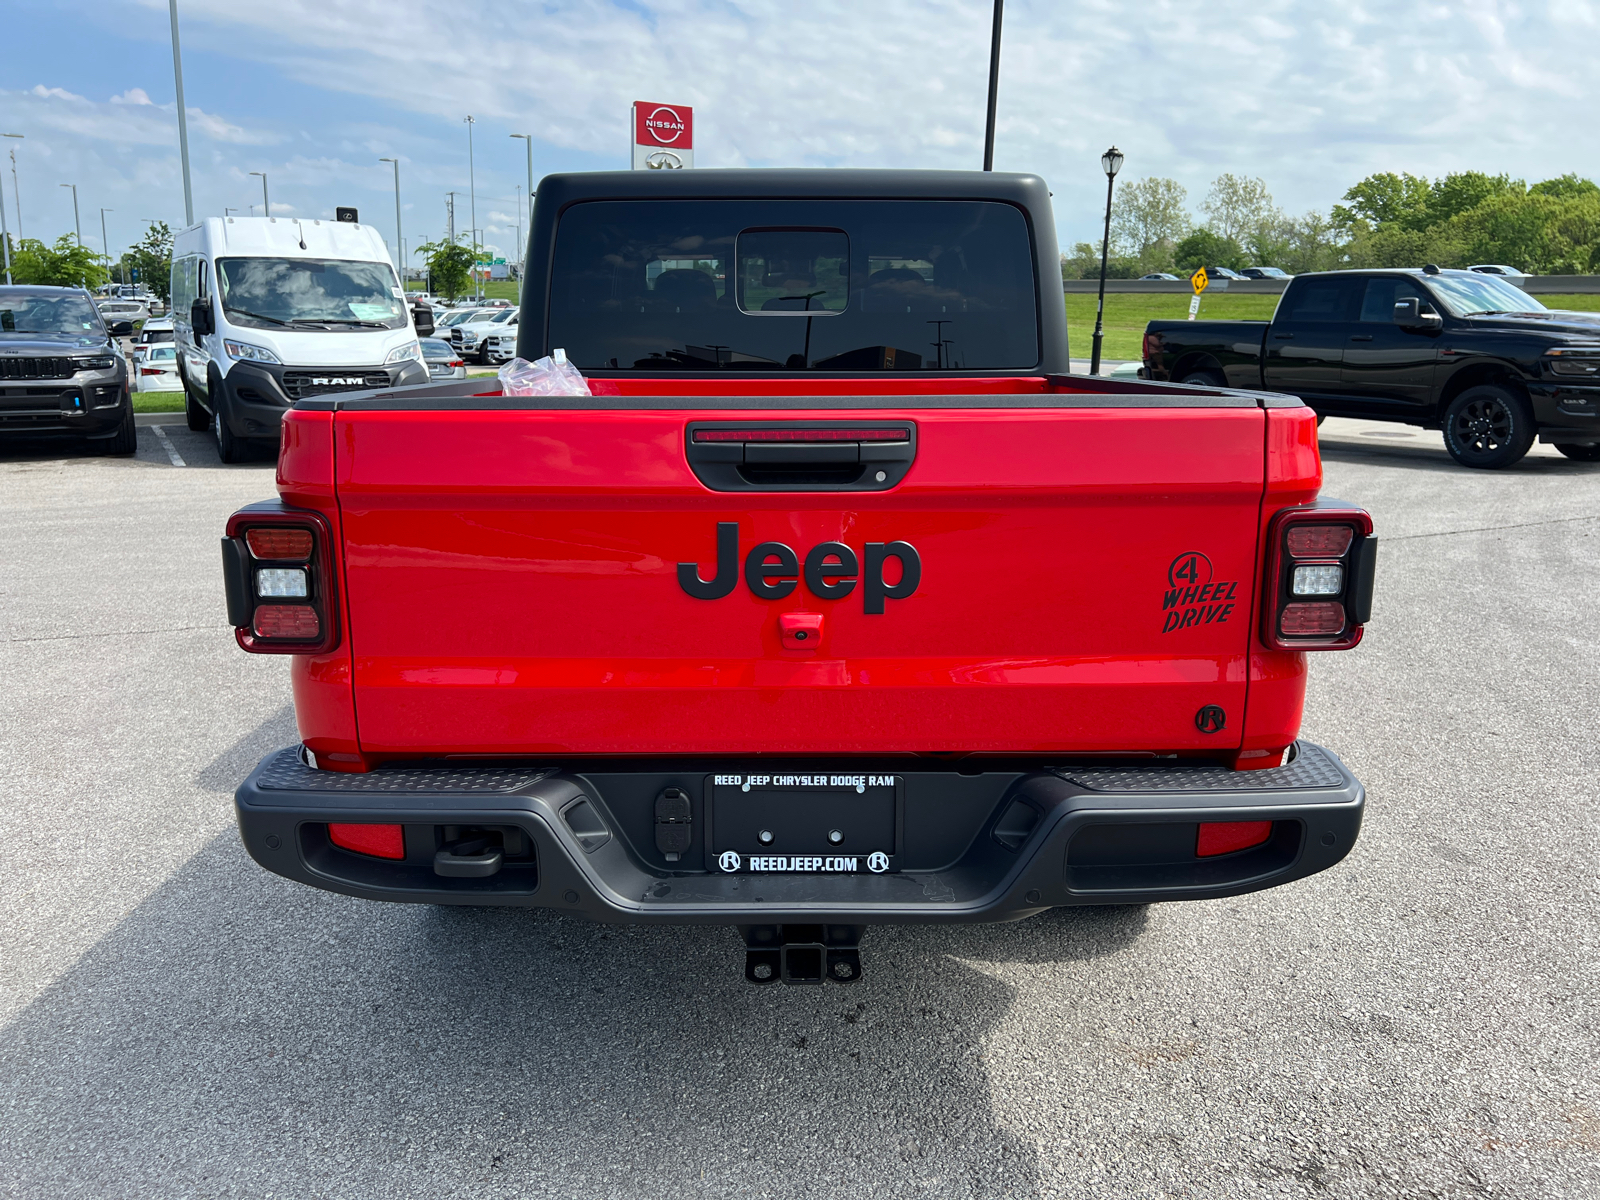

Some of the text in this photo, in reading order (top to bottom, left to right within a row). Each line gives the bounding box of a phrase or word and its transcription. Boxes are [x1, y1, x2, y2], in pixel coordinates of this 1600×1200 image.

[645, 120, 685, 130] NISSAN
[312, 377, 363, 385] RAM
[677, 521, 922, 615] Jeep
[1175, 556, 1199, 584] 4
[1162, 581, 1239, 611] WHEEL
[1162, 603, 1236, 634] DRIVE
[714, 775, 895, 786] REED JEEP CHRYSLER DODGE RAM
[750, 857, 858, 871] REEDJEEP.COM
